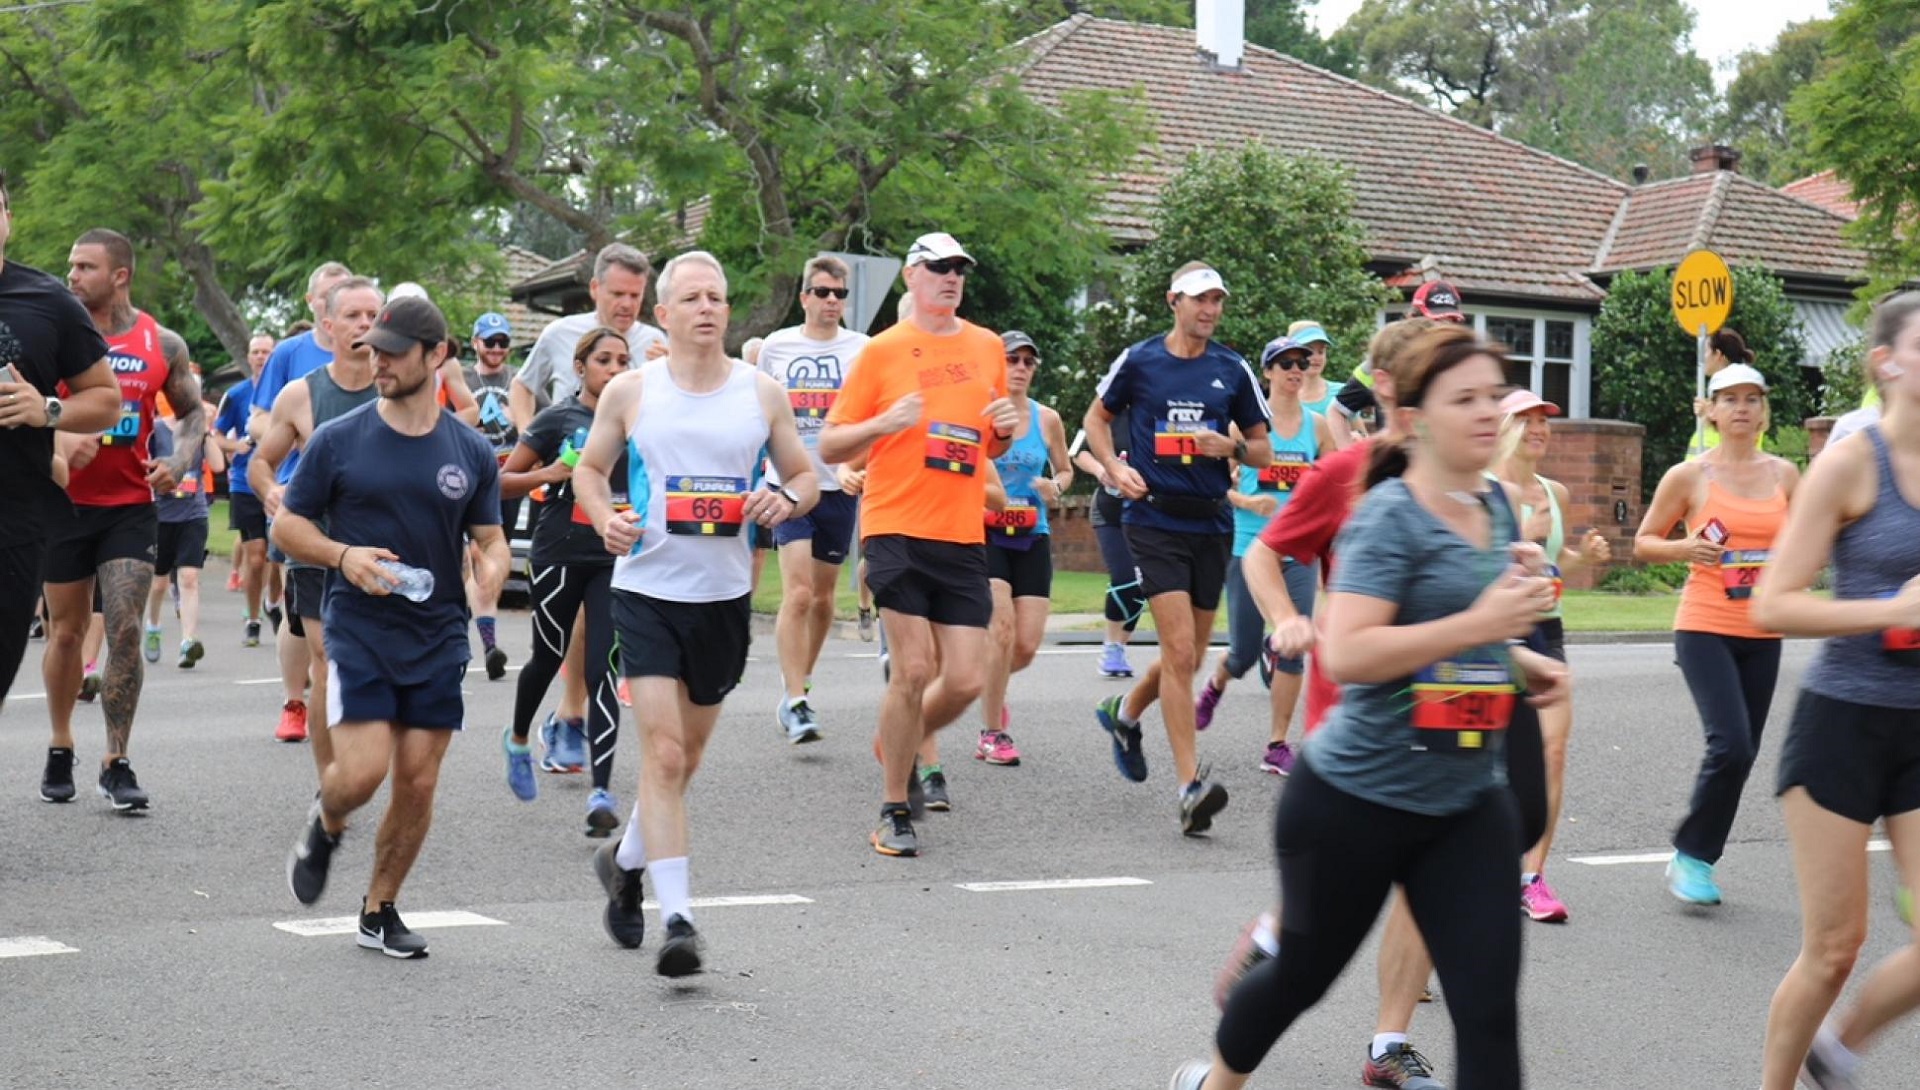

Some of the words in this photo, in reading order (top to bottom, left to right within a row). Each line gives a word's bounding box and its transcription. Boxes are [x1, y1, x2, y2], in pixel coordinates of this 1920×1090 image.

[1676, 276, 1727, 310] SLOW
[107, 356, 144, 372] ION
[798, 392, 828, 407] 311
[944, 442, 969, 461] 95
[1270, 465, 1300, 481] 595
[693, 482, 736, 492] FUNRUN
[692, 497, 723, 520] 66
[994, 509, 1026, 526] 286
